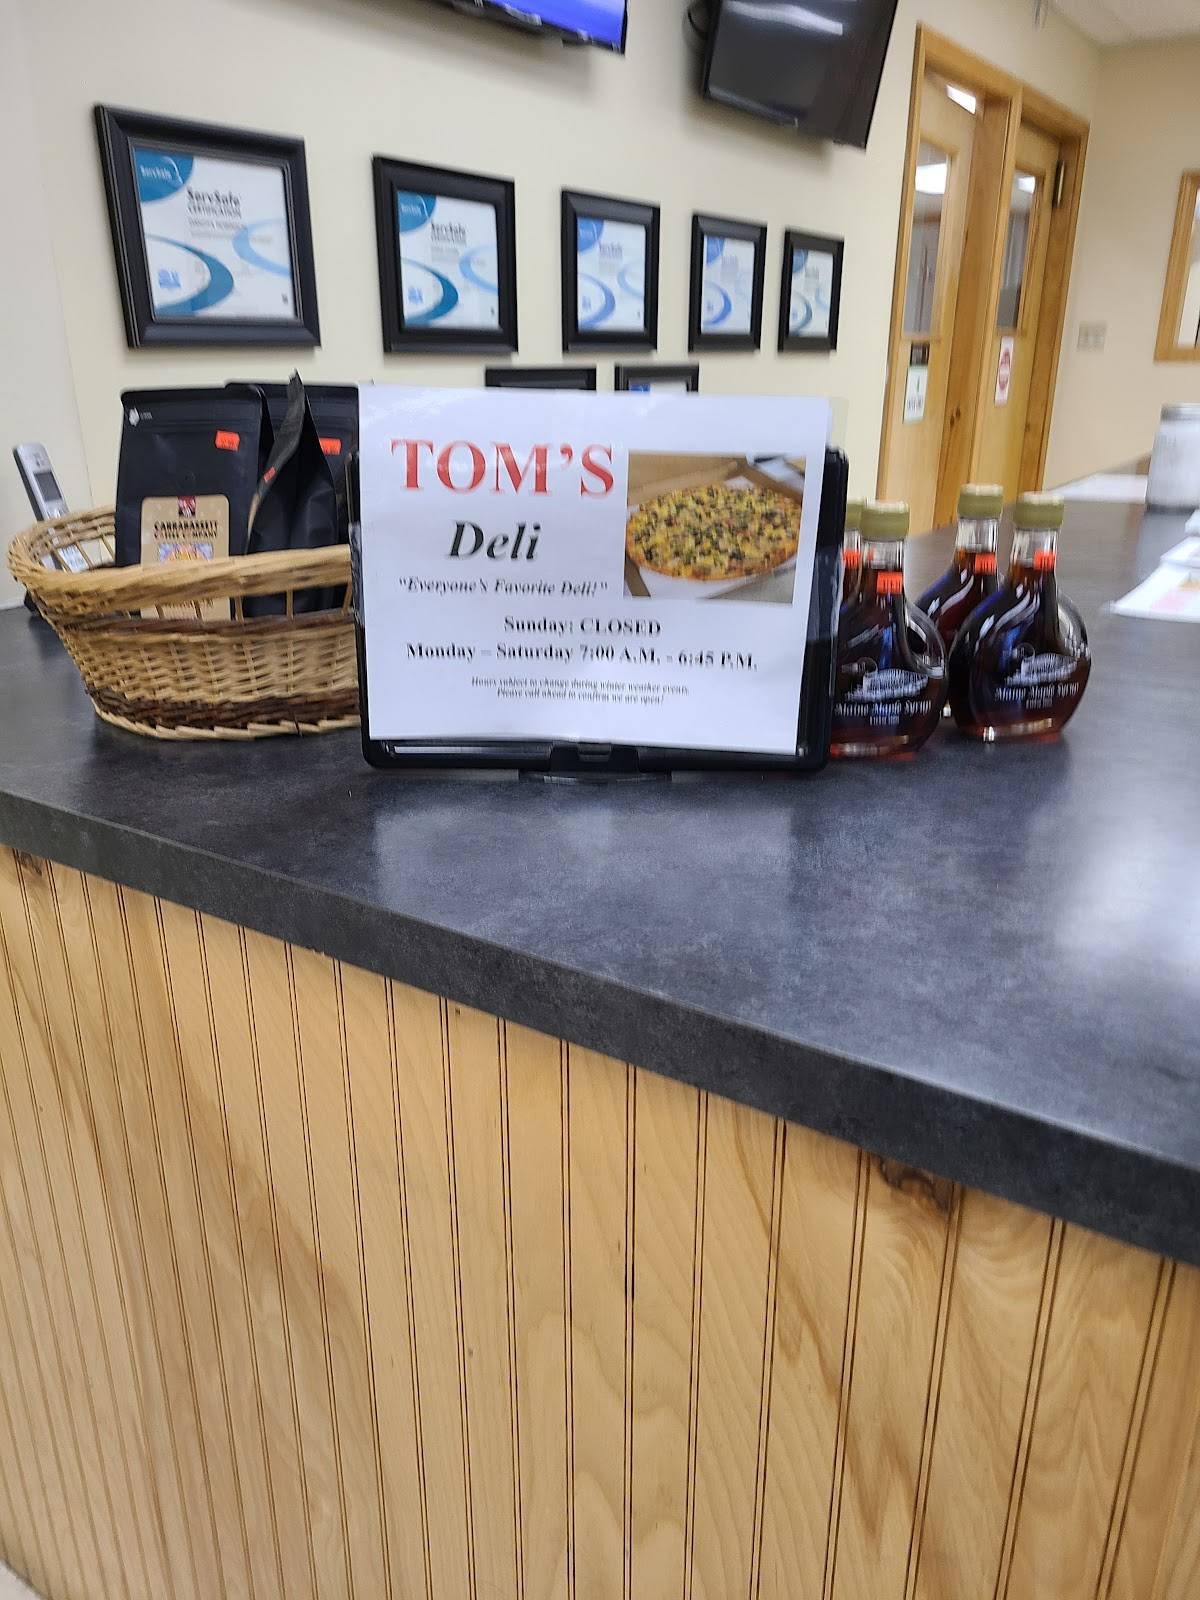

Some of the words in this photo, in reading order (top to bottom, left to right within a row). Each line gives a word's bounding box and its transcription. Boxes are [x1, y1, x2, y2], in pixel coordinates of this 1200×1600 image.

[391, 439, 614, 499] TOM'S
[447, 520, 541, 562] Deli
[494, 576, 555, 595] Favorite
[504, 615, 574, 638] Sunday:
[580, 618, 662, 637] CLOSED
[406, 642, 476, 665] Monday
[496, 642, 573, 666] Saturday
[580, 645, 615, 662] 7:00
[620, 646, 661, 665] A.M.
[678, 650, 714, 668] 6:45
[721, 651, 758, 671] P.M.
